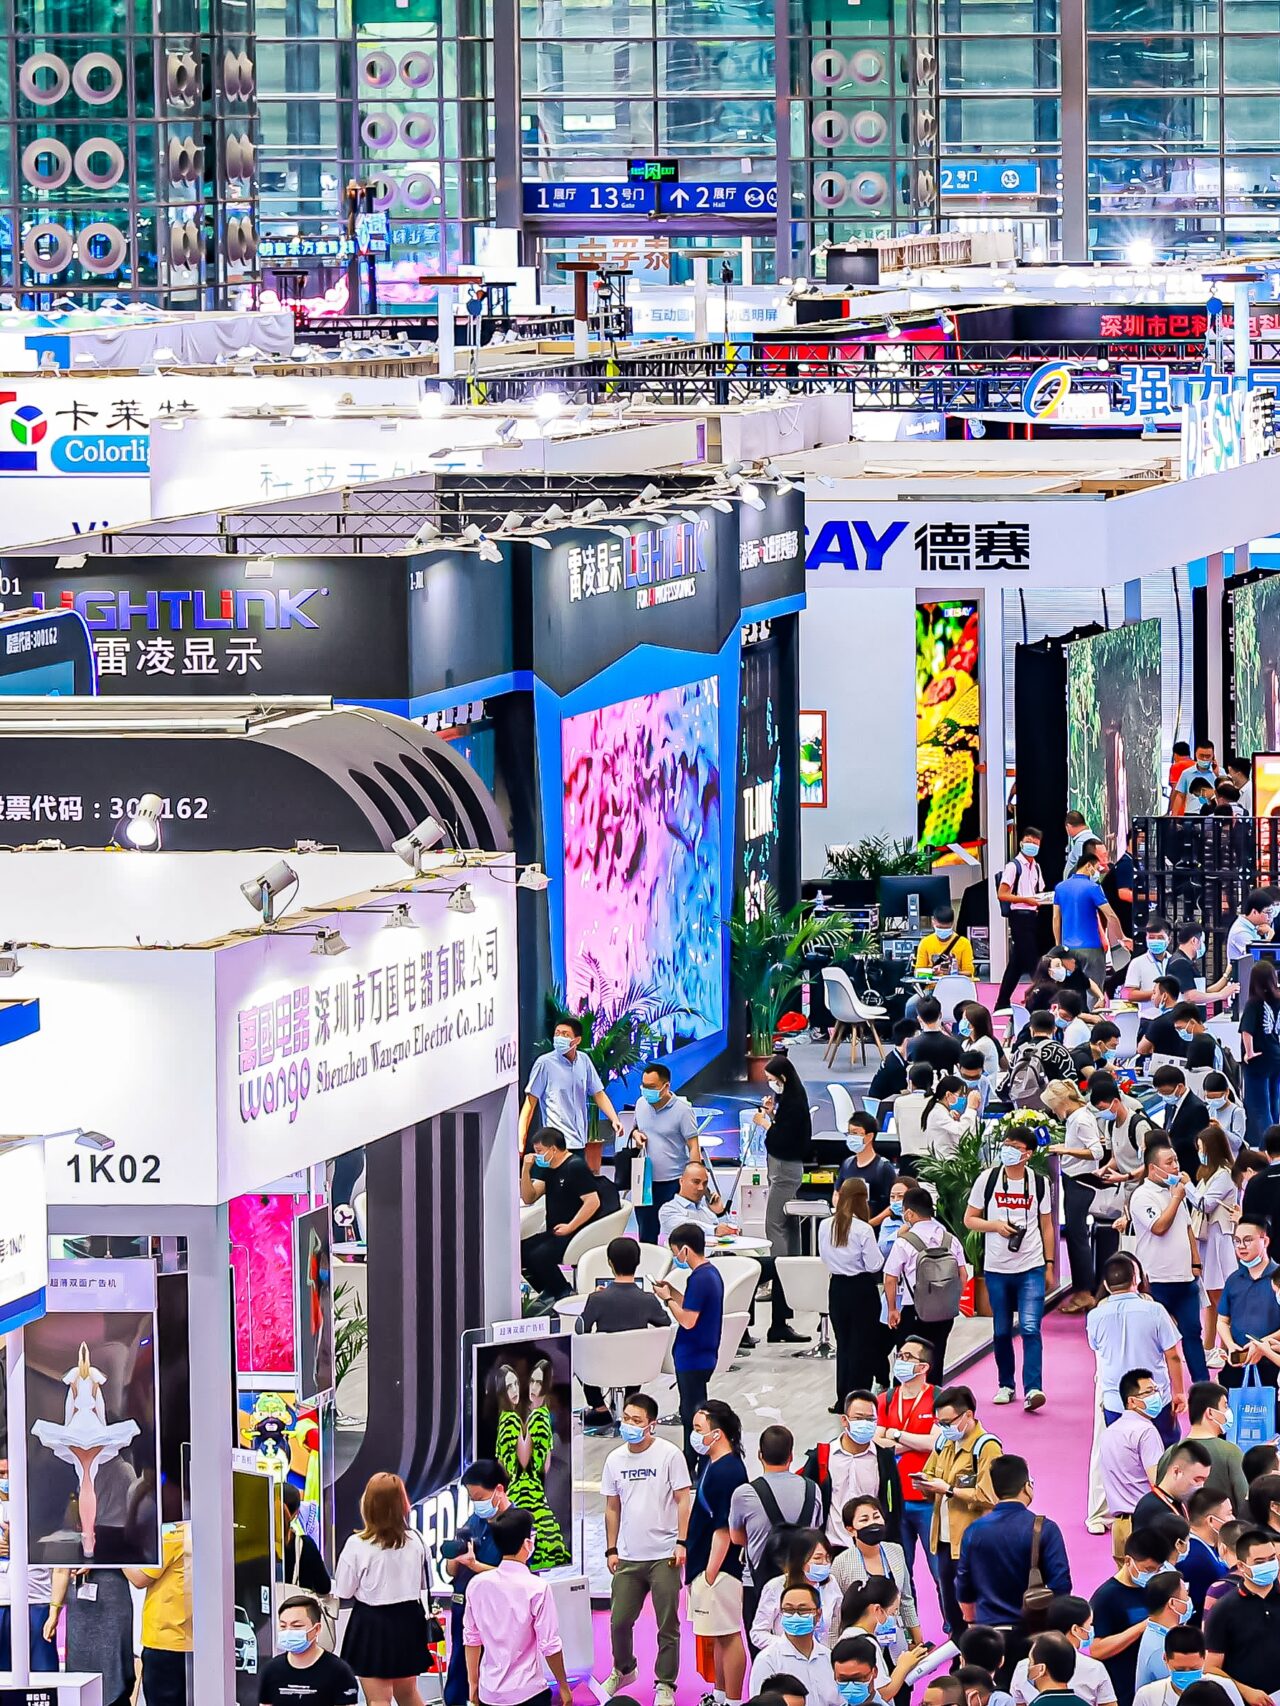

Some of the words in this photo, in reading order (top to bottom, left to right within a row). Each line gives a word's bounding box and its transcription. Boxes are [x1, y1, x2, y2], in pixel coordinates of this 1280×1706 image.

[537, 187, 550, 208] 1
[553, 188, 576, 200] 展厅
[590, 187, 619, 208] 13
[621, 188, 645, 200] 号门
[696, 187, 710, 208] 2
[713, 188, 736, 200] 展厅
[804, 521, 910, 570] AY
[914, 521, 1031, 571] 德赛
[568, 543, 622, 603] 雷凌显示
[94, 637, 263, 677] 雷凌显示
[314, 927, 498, 1046] 深圳市万国电器有限公司
[316, 1051, 368, 1094] Shenzhen
[412, 1015, 454, 1057] Electric
[495, 1041, 517, 1074] 1K02
[67, 1154, 161, 1184] 1K02
[50, 1278, 117, 1288] 超薄双面广告机
[621, 1468, 656, 1479] TRAIN
